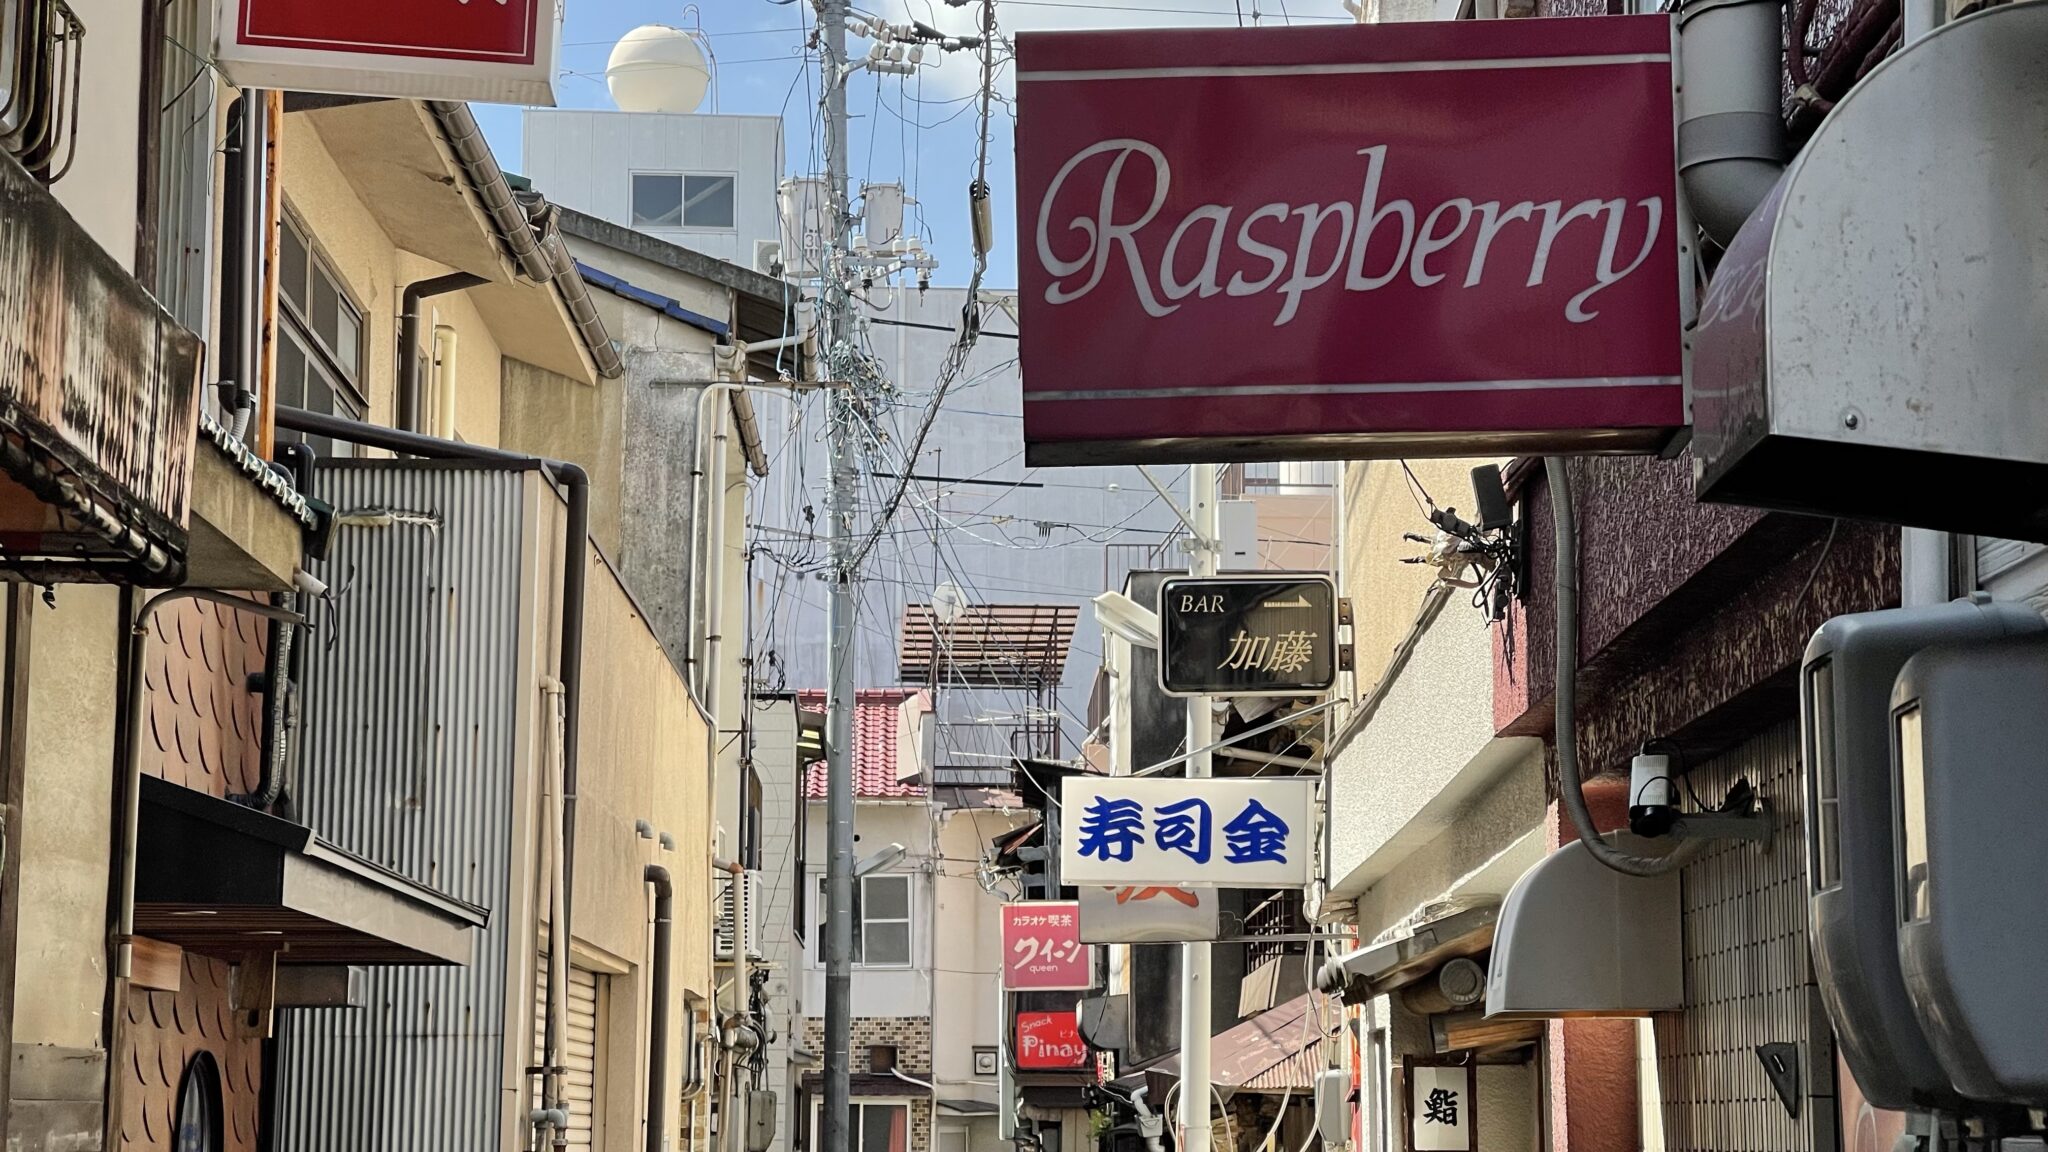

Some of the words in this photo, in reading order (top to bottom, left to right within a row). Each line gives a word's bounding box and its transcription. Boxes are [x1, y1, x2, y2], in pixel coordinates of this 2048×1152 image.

[1036, 138, 1663, 326] Raspberry
[1180, 594, 1225, 613] BAR
[1217, 629, 1318, 673] 加藤
[1077, 795, 1290, 864] 寿司金
[1013, 914, 1072, 927] カラオケ喫茶
[1029, 964, 1058, 977] queen
[1021, 1015, 1053, 1034] Snack
[1022, 1034, 1087, 1065] Pinay
[1423, 1087, 1459, 1127] 鮨
